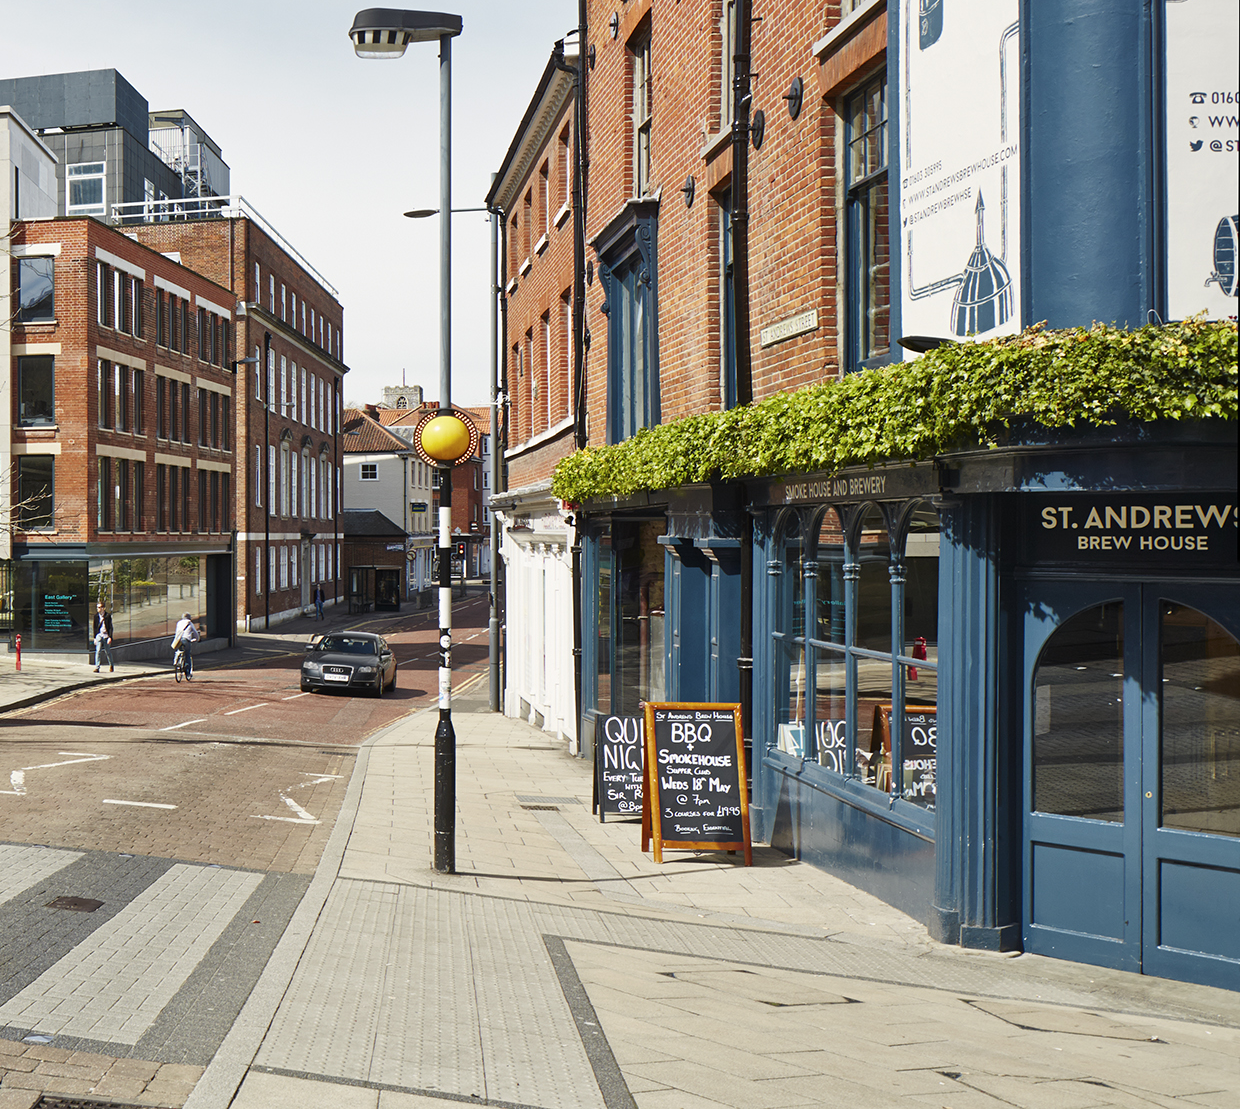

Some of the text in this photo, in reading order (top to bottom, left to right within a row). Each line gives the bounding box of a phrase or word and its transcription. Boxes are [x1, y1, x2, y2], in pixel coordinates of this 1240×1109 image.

[908, 144, 1018, 204] WWW.STANDREWSBREWHOUSE.COM
[797, 313, 815, 331] STREET
[785, 476, 887, 500] SMOKE HOUSE AND BREWERY
[1041, 505, 1238, 529] ST. ANDREW
[1078, 536, 1209, 550] BREW HOUSE
[605, 716, 644, 746] QUI
[671, 723, 712, 743] BBQ
[604, 744, 644, 771] NIG
[658, 749, 732, 767] SMOKEHOUSE
[604, 772, 626, 783] EVERY
[661, 776, 689, 790] WEDS
[709, 777, 732, 793] MAY
[607, 789, 626, 801] SIR
[665, 808, 674, 819] 3
